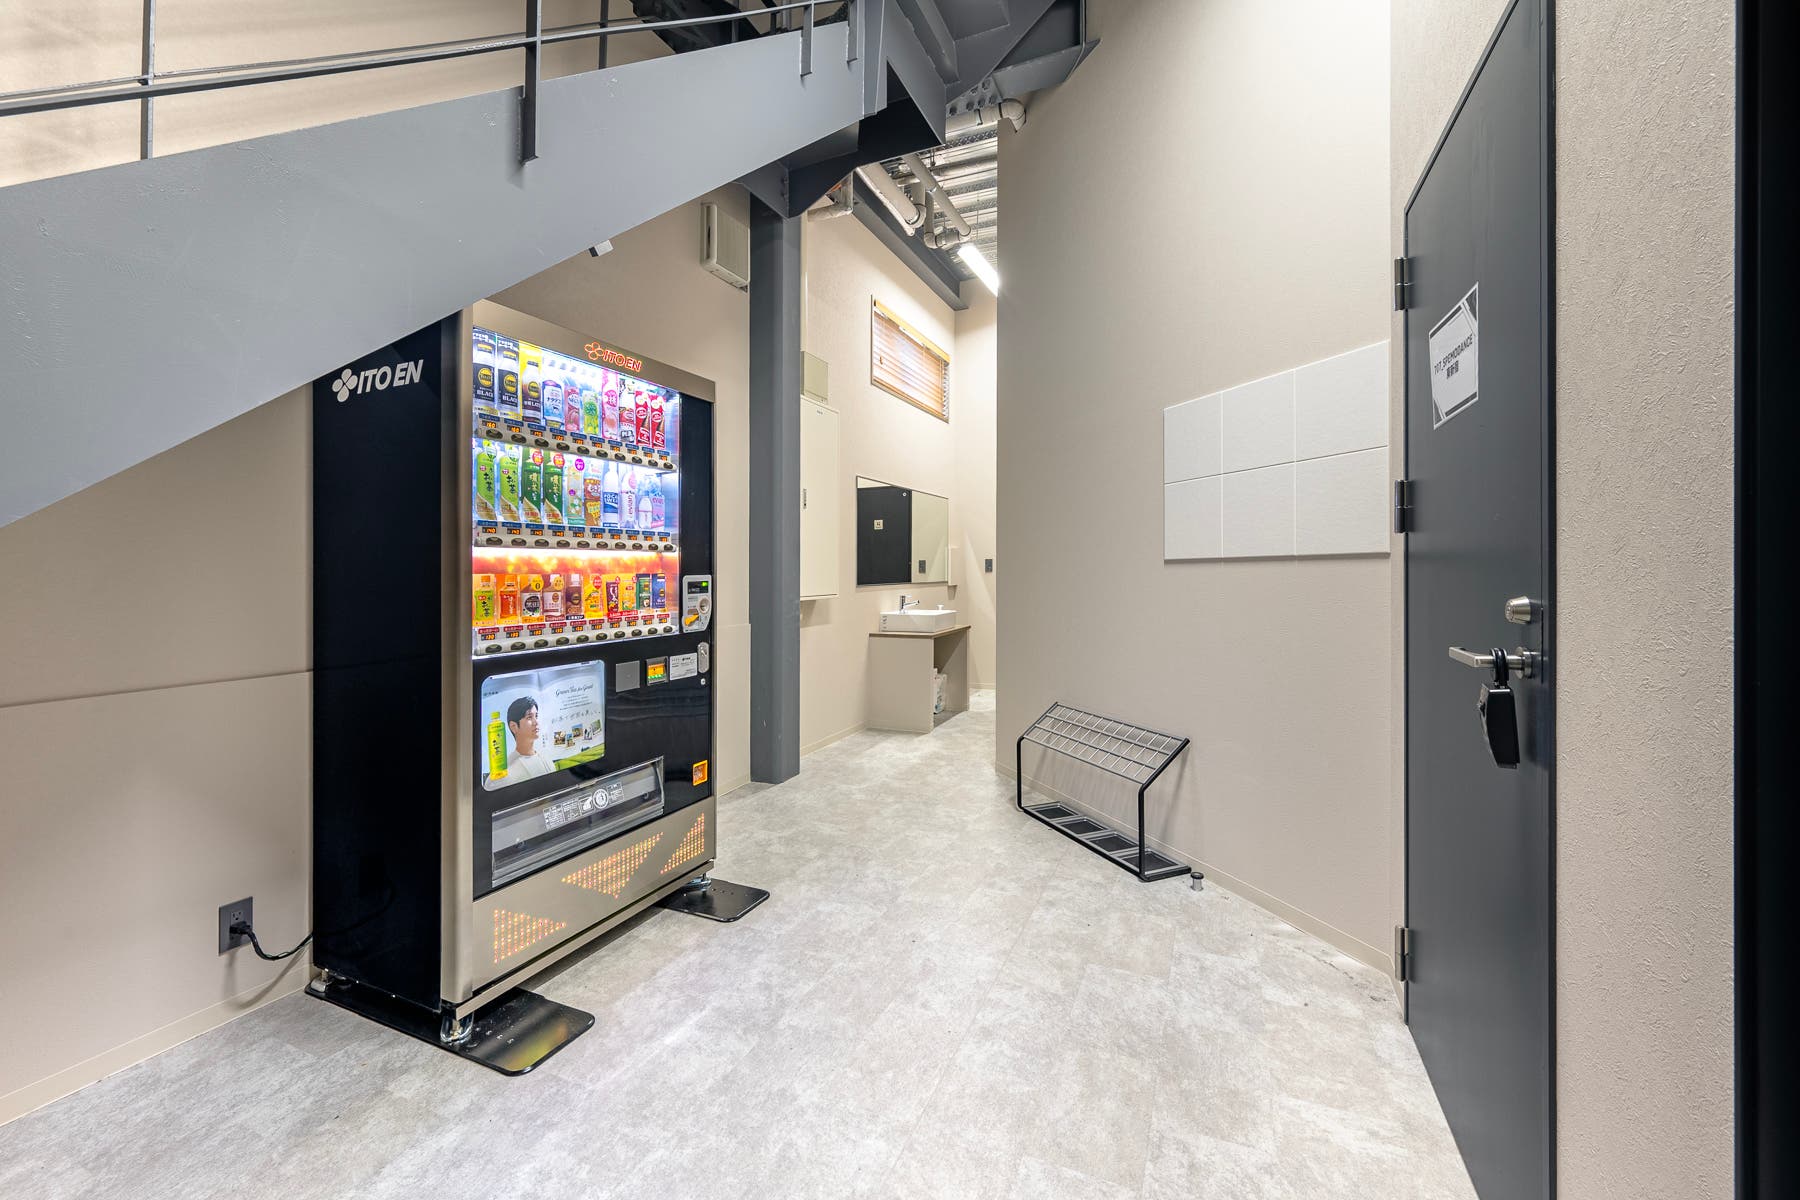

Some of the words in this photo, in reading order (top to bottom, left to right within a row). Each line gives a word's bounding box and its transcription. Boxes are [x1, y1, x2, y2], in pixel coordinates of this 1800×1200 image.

[603, 350, 626, 367] ITO
[625, 357, 642, 372] EN
[357, 366, 392, 394] ITO
[393, 359, 424, 387] EN
